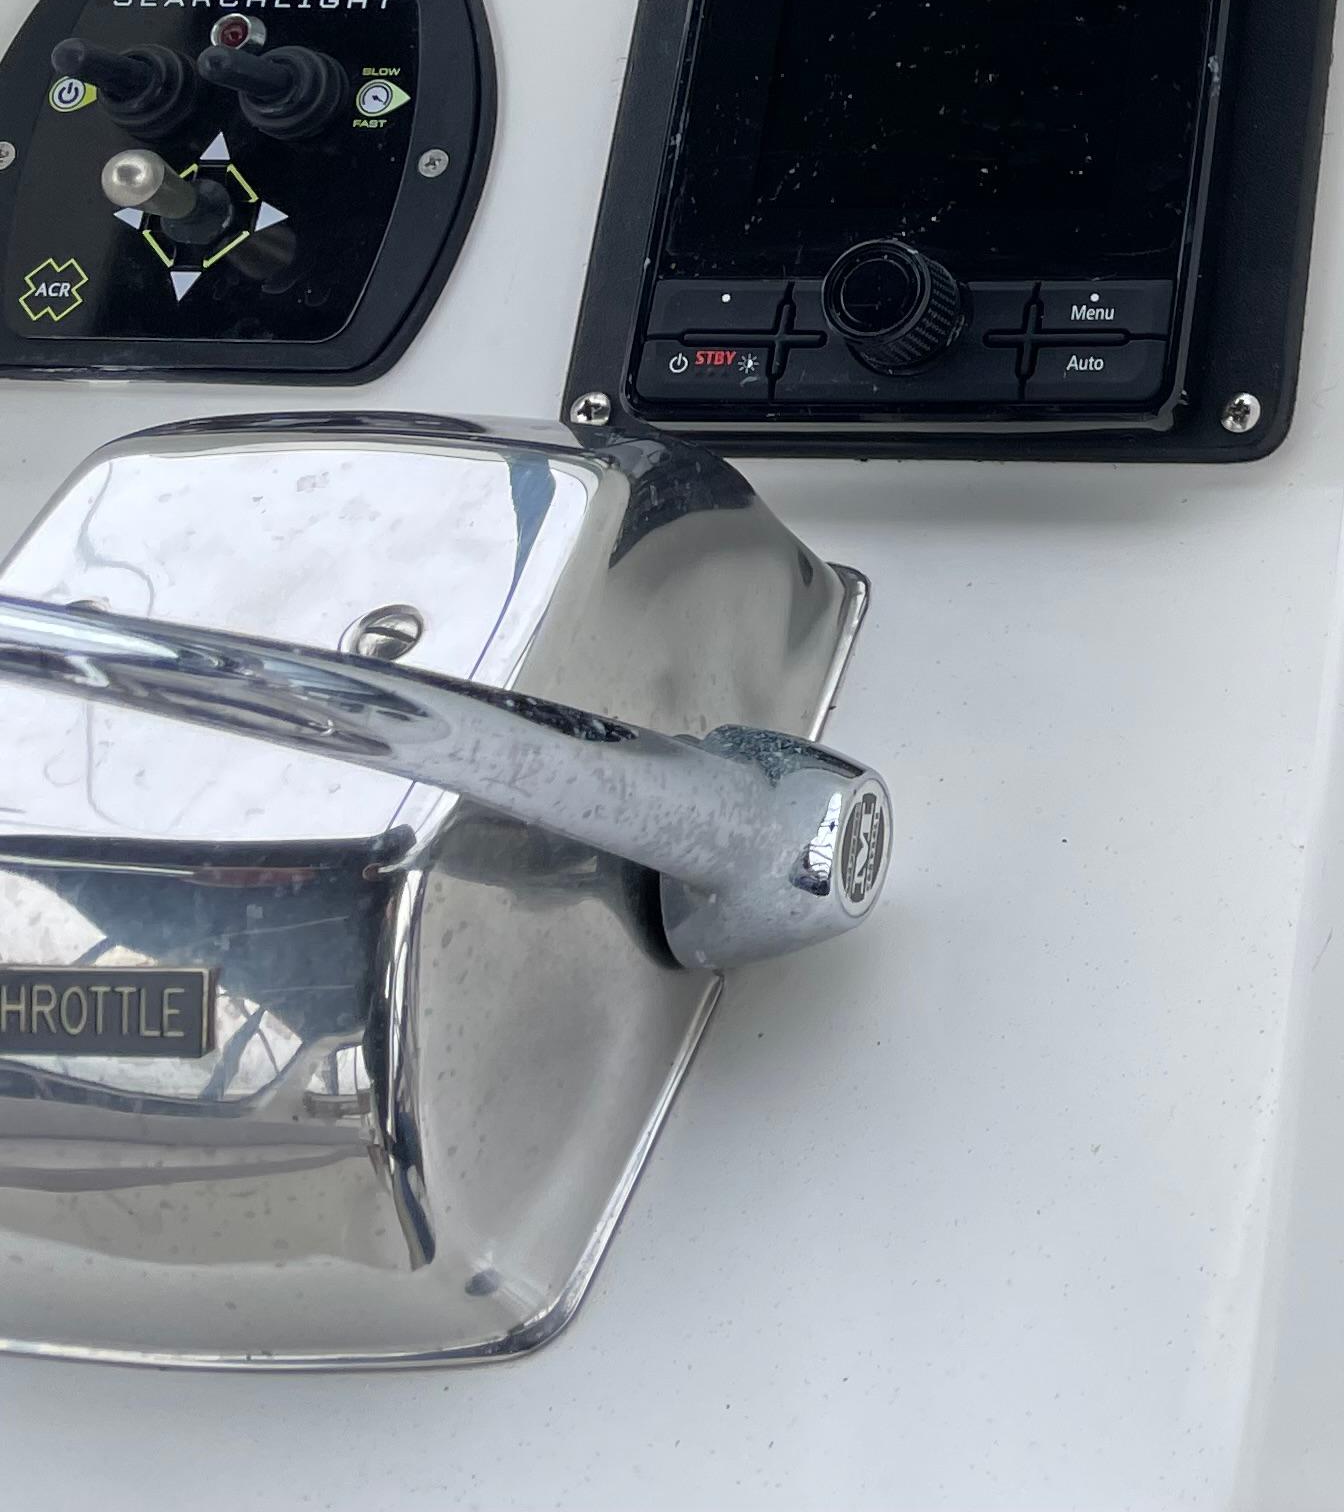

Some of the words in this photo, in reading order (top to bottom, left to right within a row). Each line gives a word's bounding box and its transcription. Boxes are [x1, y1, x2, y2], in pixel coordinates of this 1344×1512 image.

[362, 67, 401, 77] SLOW
[352, 119, 388, 129] FAST
[34, 281, 72, 298] ACR
[1070, 304, 1115, 321] Menu
[694, 350, 737, 366] STBY
[1066, 354, 1105, 371] Auto
